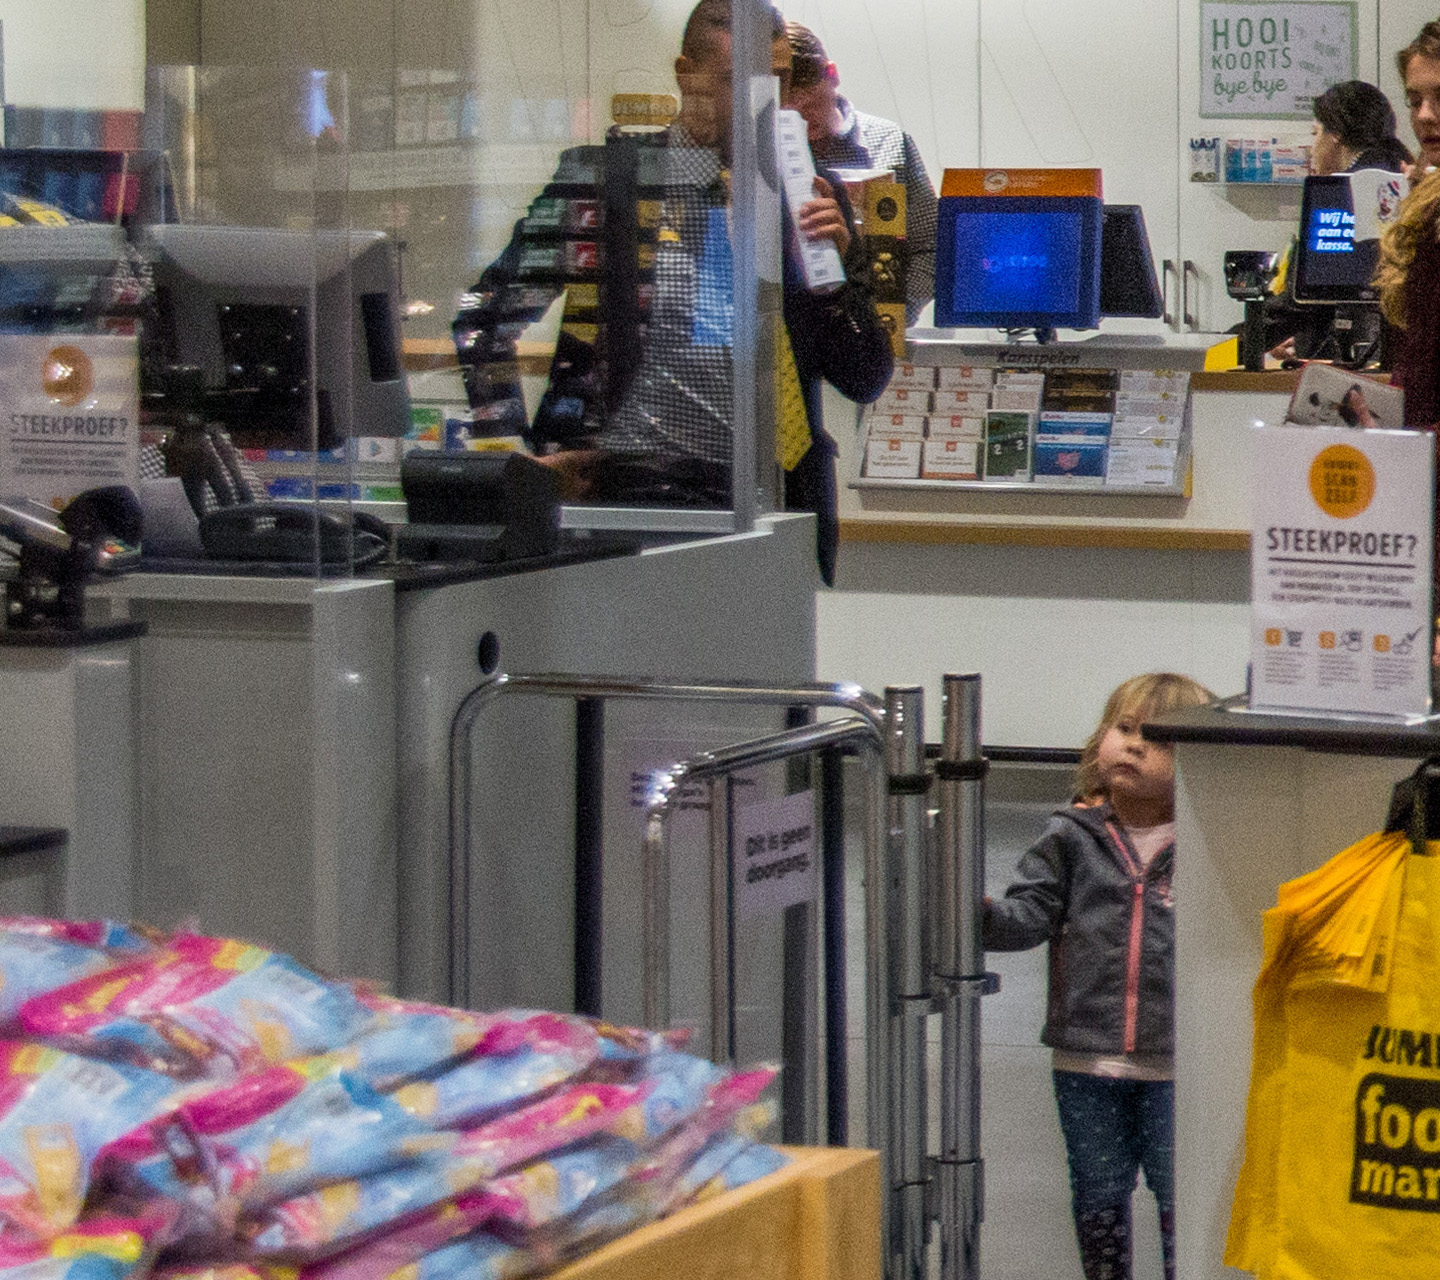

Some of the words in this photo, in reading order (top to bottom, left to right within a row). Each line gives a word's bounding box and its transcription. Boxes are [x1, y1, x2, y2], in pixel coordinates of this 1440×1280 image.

[1212, 17, 1290, 52] HOOI
[1211, 47, 1292, 71] KOORTS
[1214, 73, 1249, 103] bye
[1252, 70, 1288, 101] bye
[1320, 212, 1342, 227] Wij
[1318, 228, 1341, 238] aan
[1317, 239, 1354, 252] kassa.
[997, 348, 1081, 369] Kansspelen
[10, 414, 128, 437] STEEKPROEF?
[1266, 526, 1418, 558] STEEKPROEF?
[746, 833, 766, 857] Dit
[767, 831, 779, 850] is
[781, 824, 812, 852] geen
